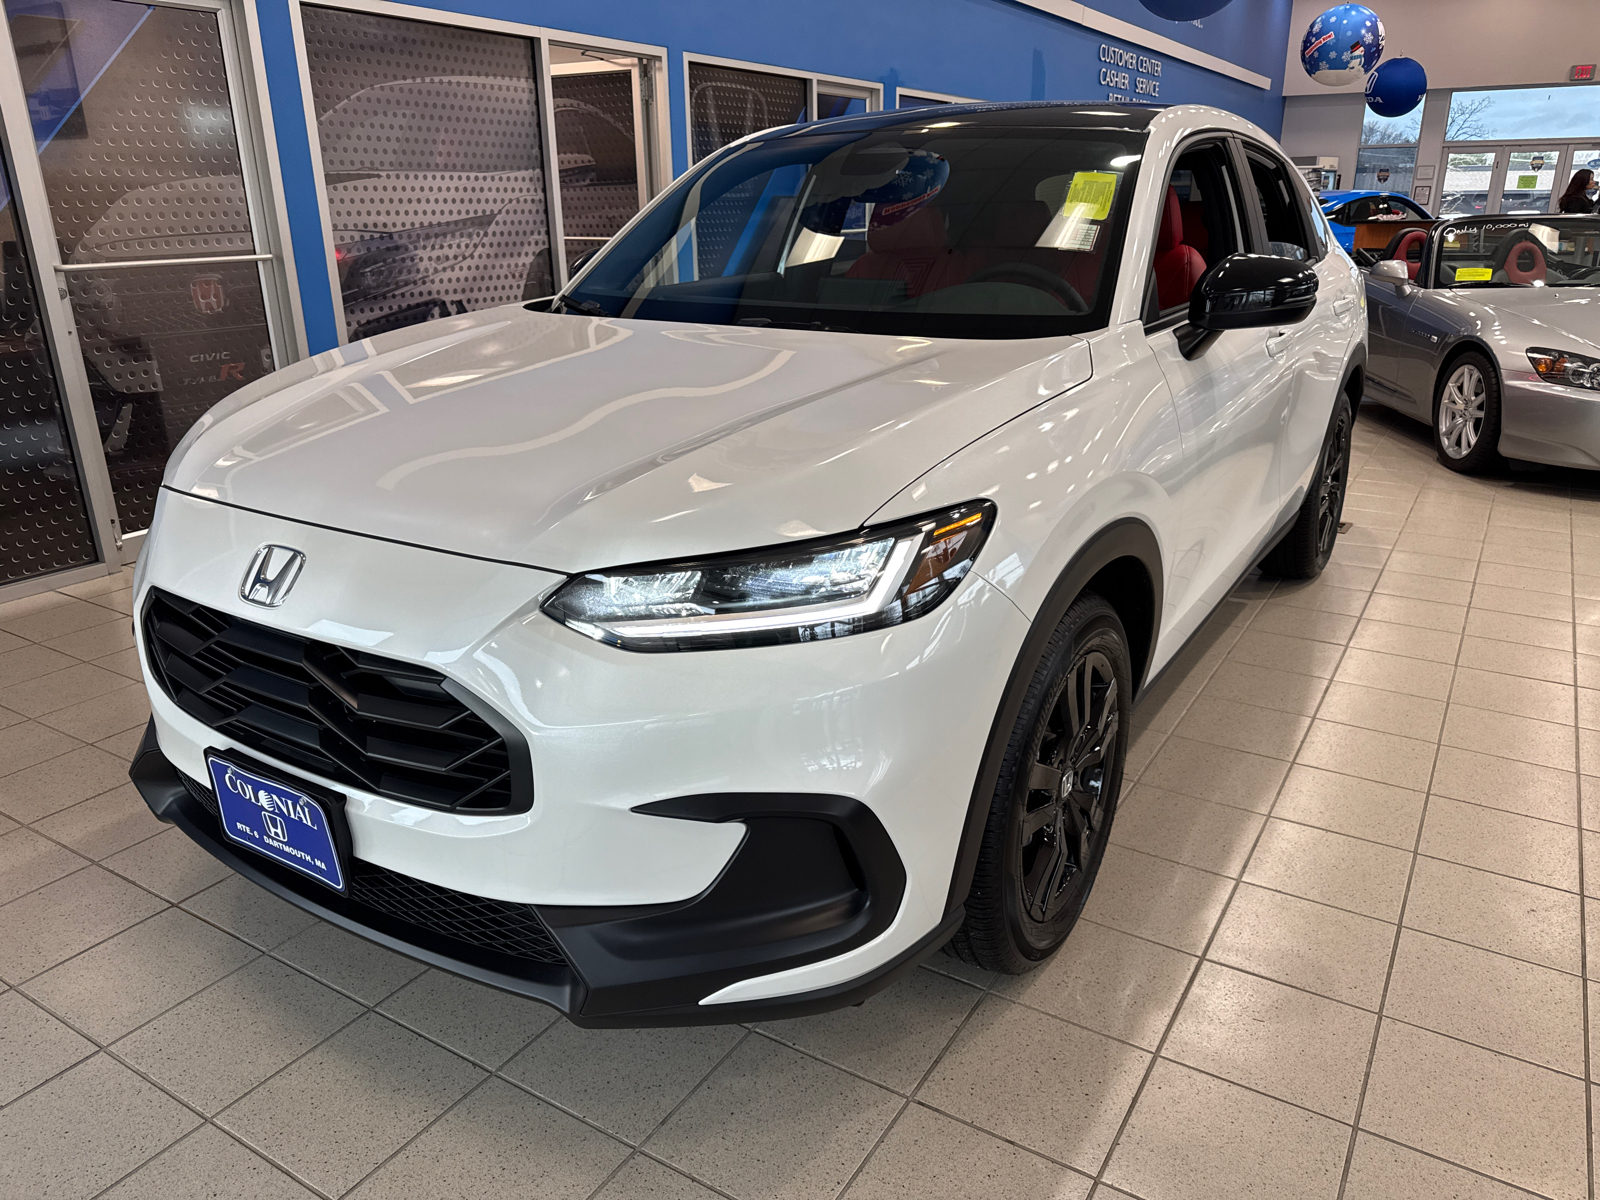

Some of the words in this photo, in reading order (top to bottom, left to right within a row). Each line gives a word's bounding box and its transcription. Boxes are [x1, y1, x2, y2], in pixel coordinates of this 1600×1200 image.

[1100, 44, 1137, 70] CUSTOMER
[1138, 56, 1162, 77] CENTER
[1575, 65, 1593, 78] EXIT
[1100, 68, 1130, 90] CASHIER
[1135, 77, 1160, 97] SERVICE
[1443, 225, 1477, 237] Only
[1482, 222, 1517, 231] 10,000
[189, 351, 231, 363] CIVIC
[218, 362, 246, 382] R
[253, 830, 260, 839] 6
[314, 858, 328, 871] MA
